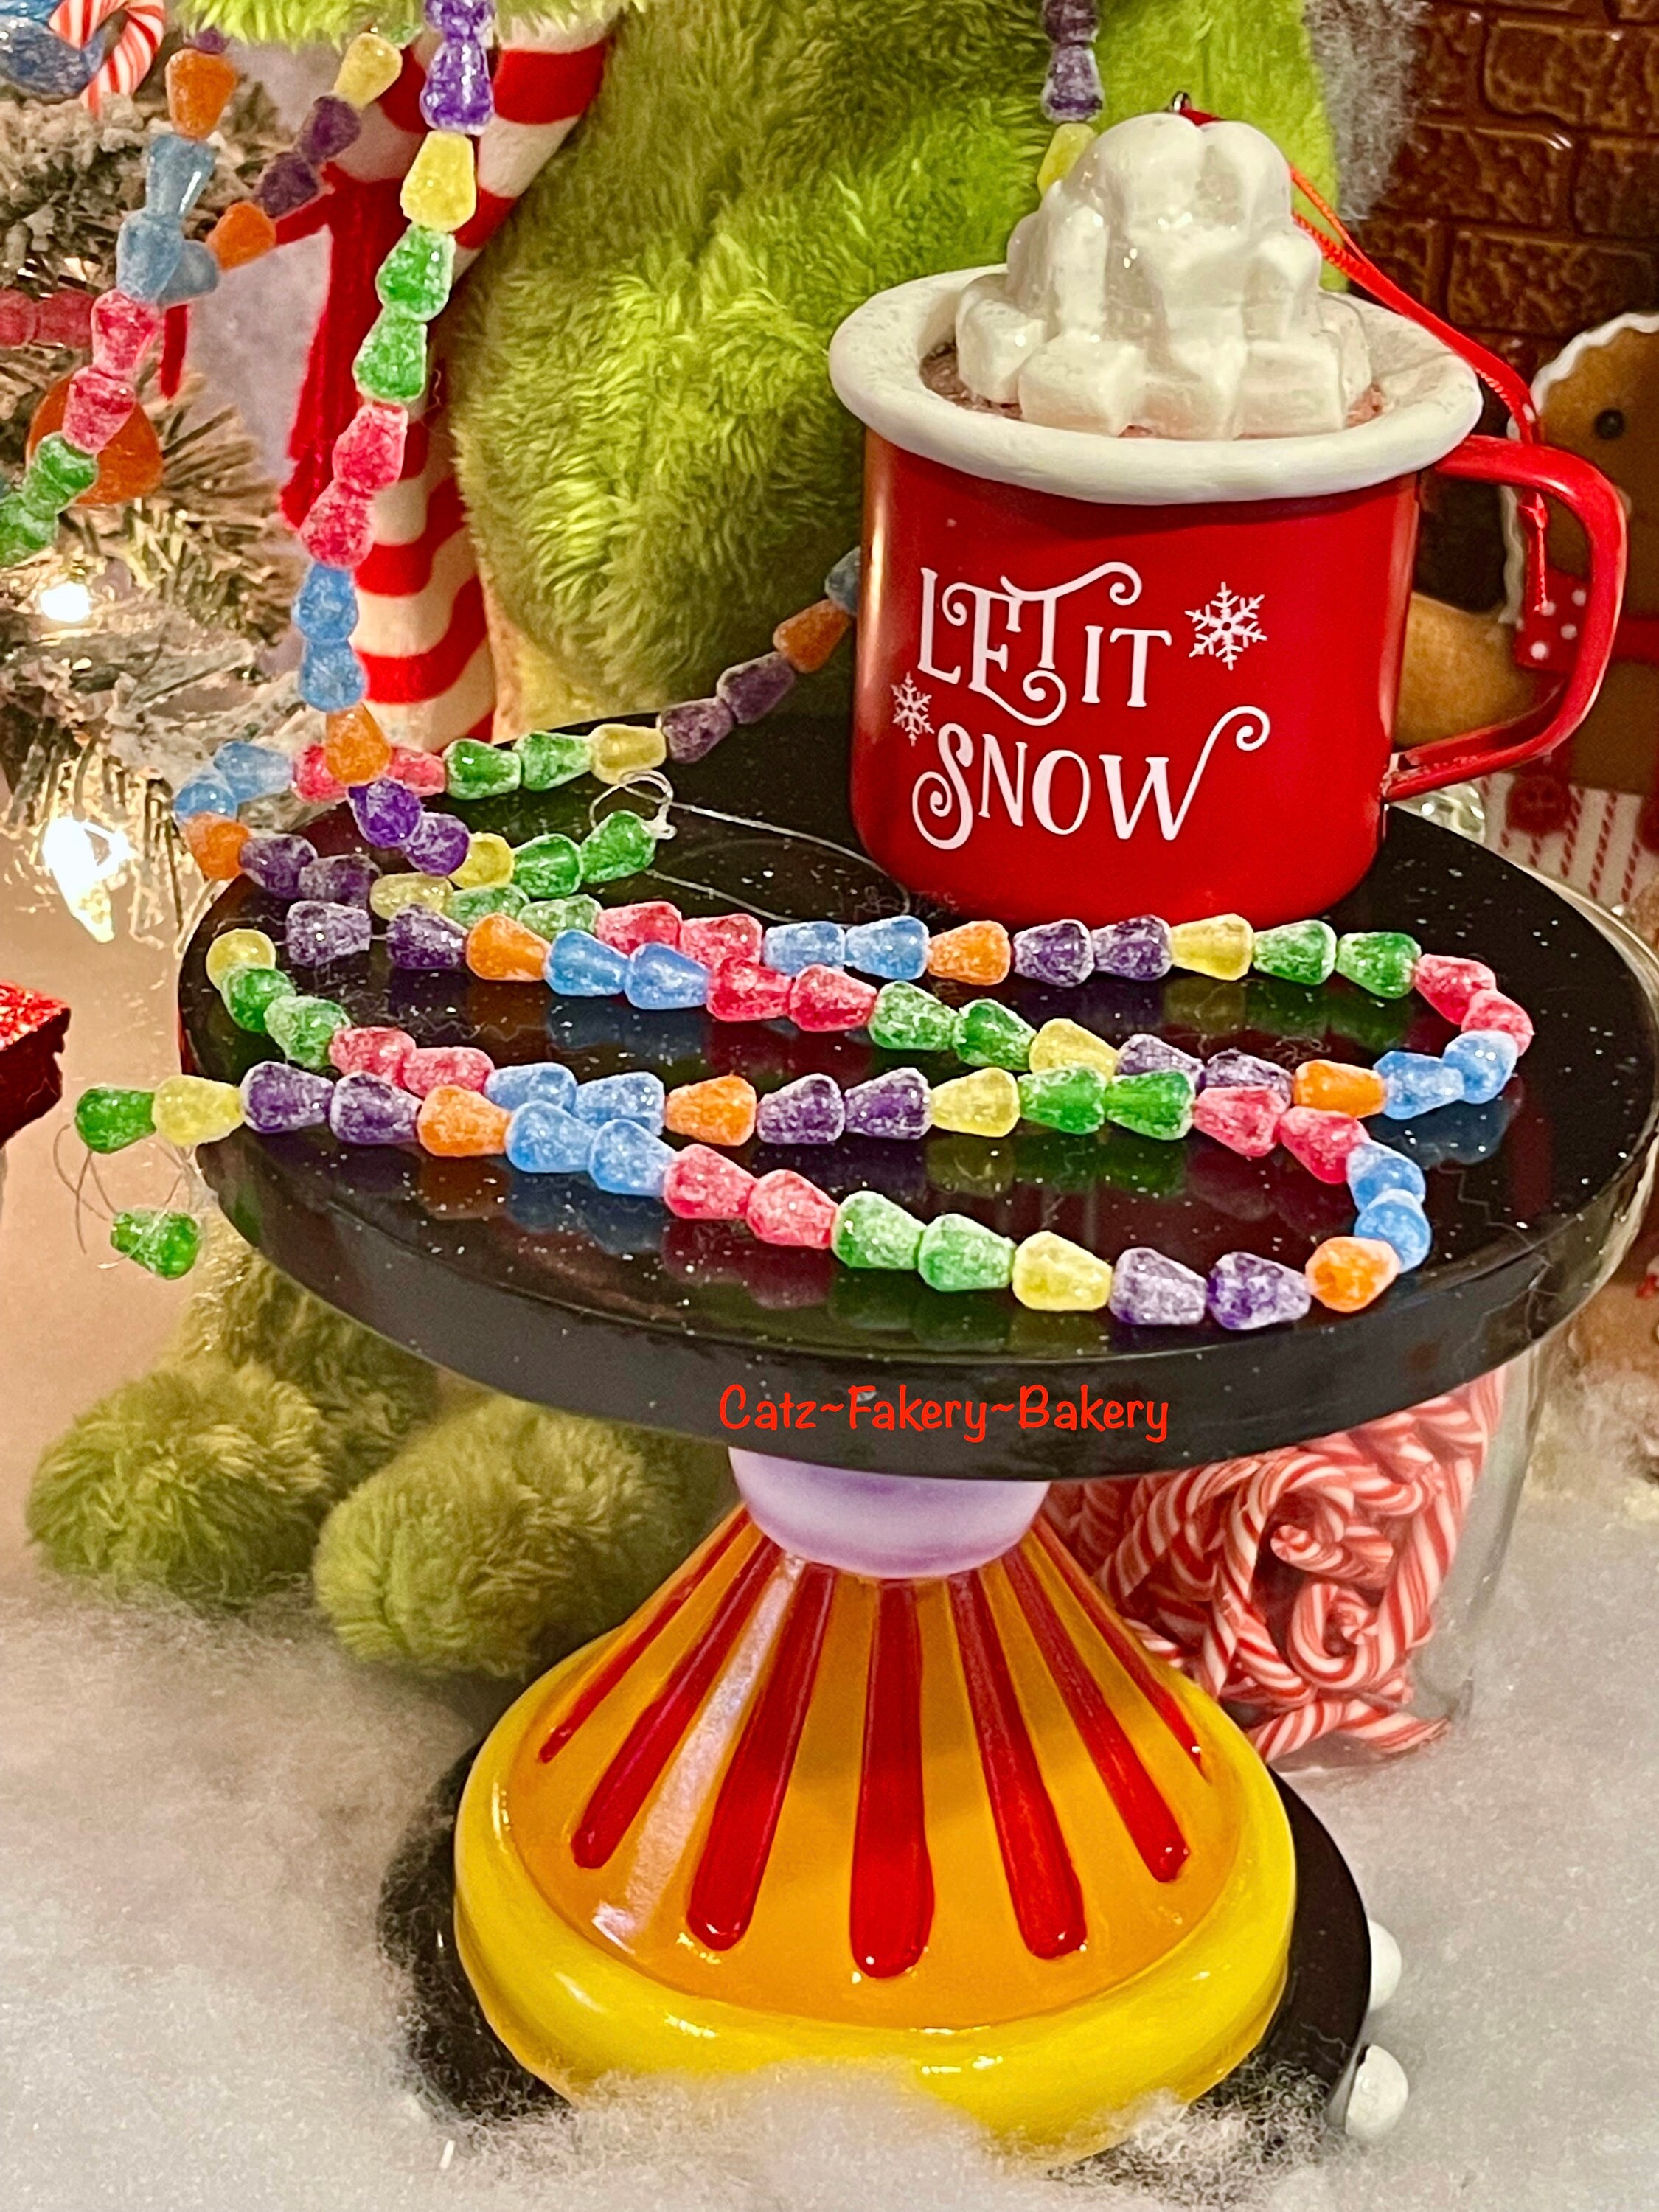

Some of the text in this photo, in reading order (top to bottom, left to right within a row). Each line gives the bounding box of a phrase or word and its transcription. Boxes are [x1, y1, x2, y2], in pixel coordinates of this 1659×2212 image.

[917, 561, 1172, 726] LET IT
[912, 706, 1270, 850] SNOW
